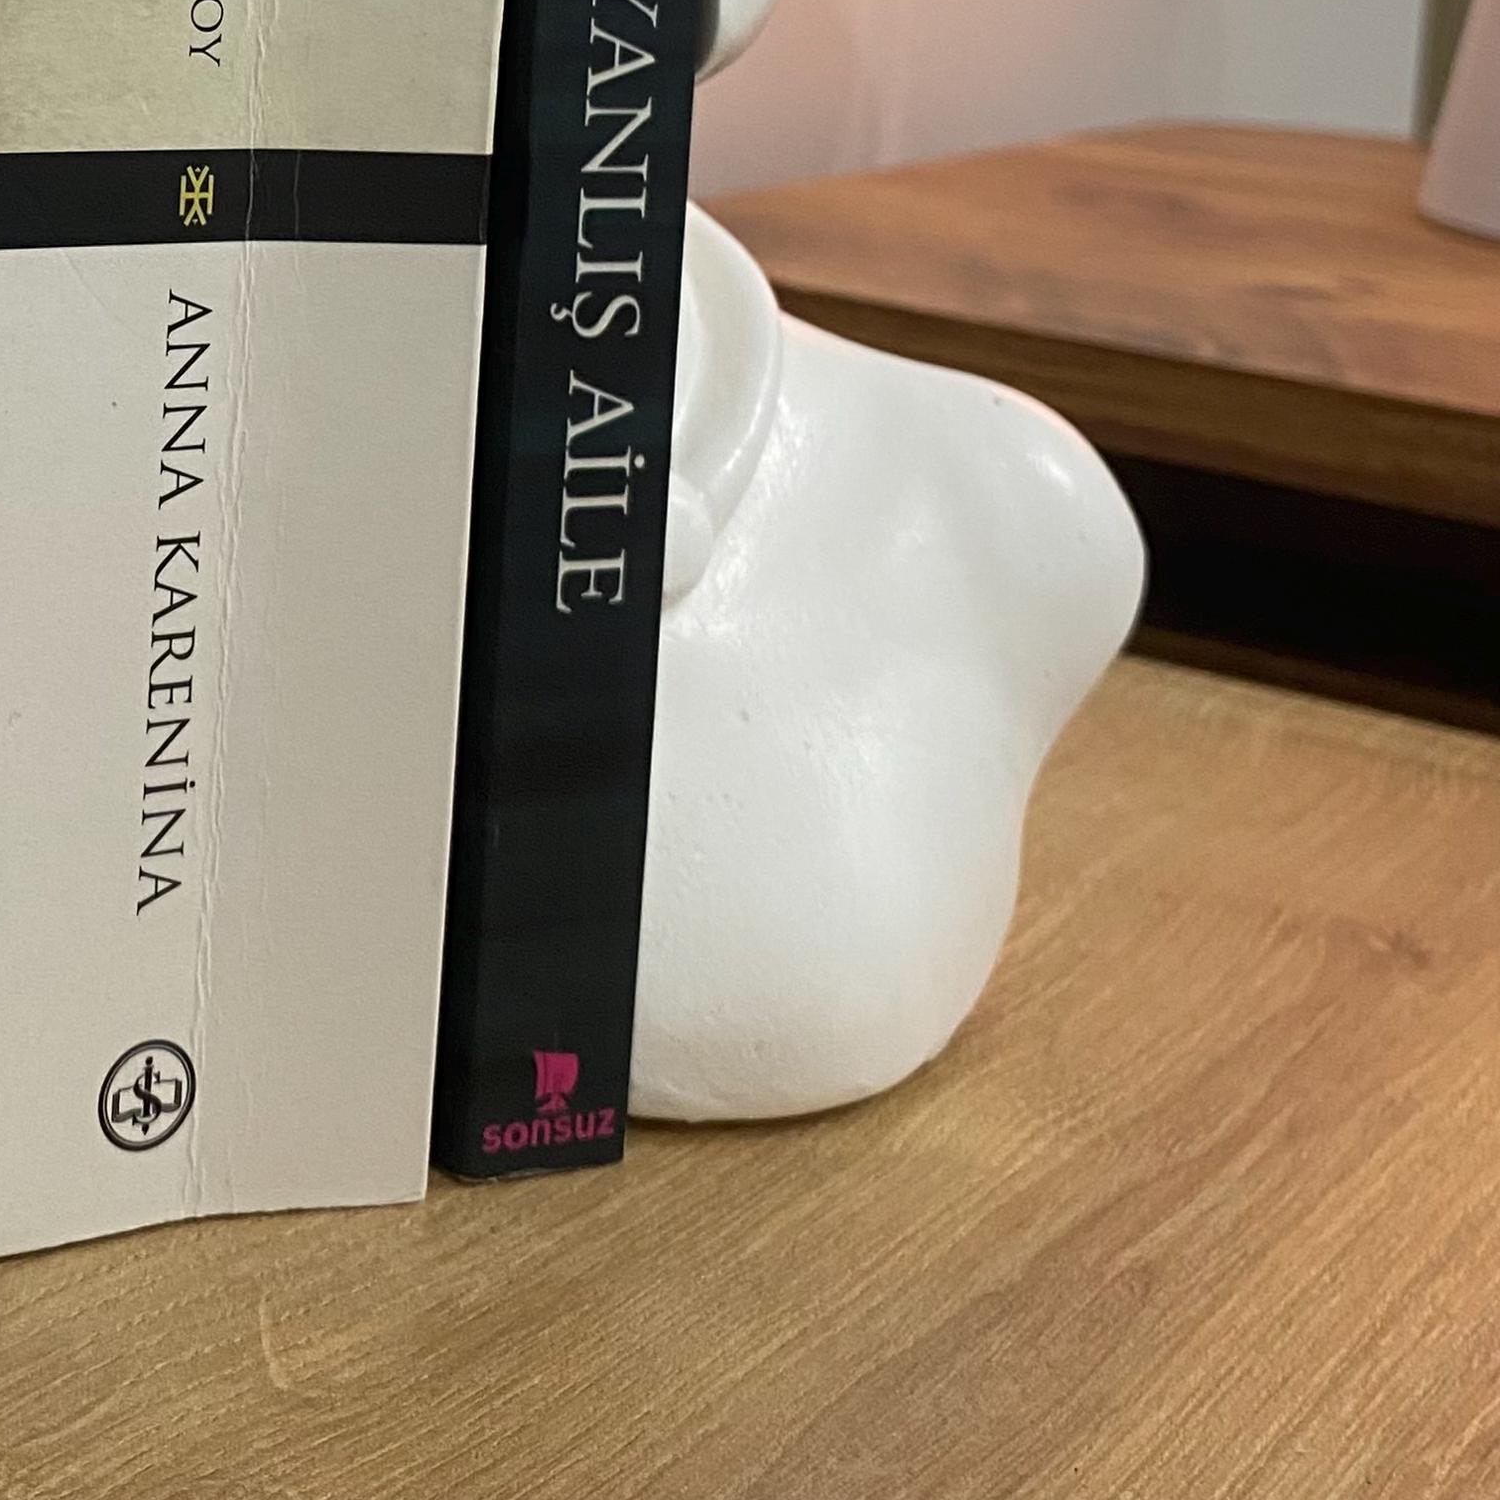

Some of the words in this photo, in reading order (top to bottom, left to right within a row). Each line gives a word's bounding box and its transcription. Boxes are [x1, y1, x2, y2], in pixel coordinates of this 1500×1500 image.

[158, 289, 212, 508] ANNA
[554, 368, 646, 614] AİLE
[136, 530, 201, 913] KARENİNA
[481, 1106, 617, 1154] sonsuz
